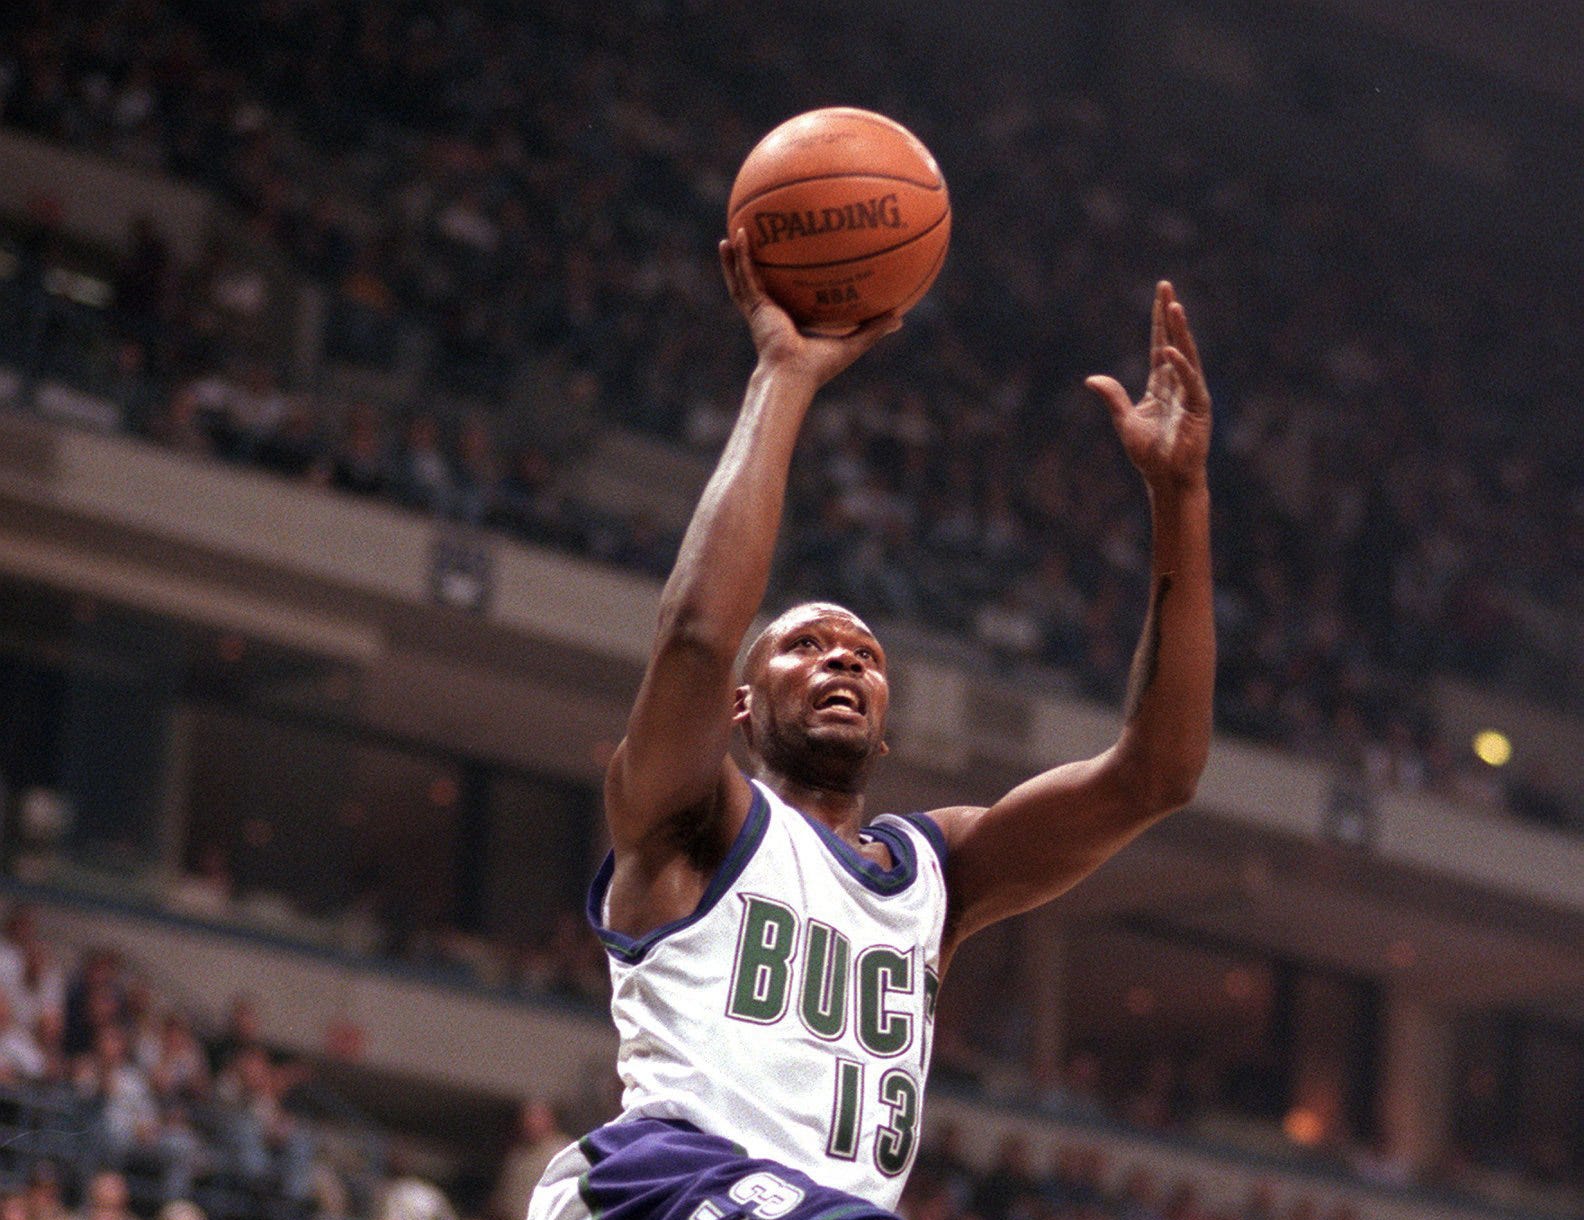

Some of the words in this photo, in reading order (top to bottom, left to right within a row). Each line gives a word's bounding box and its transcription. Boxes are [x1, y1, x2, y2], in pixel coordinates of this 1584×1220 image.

[753, 193, 902, 249] SPALDING
[725, 892, 939, 1060] BUC
[825, 1056, 920, 1179] 13
